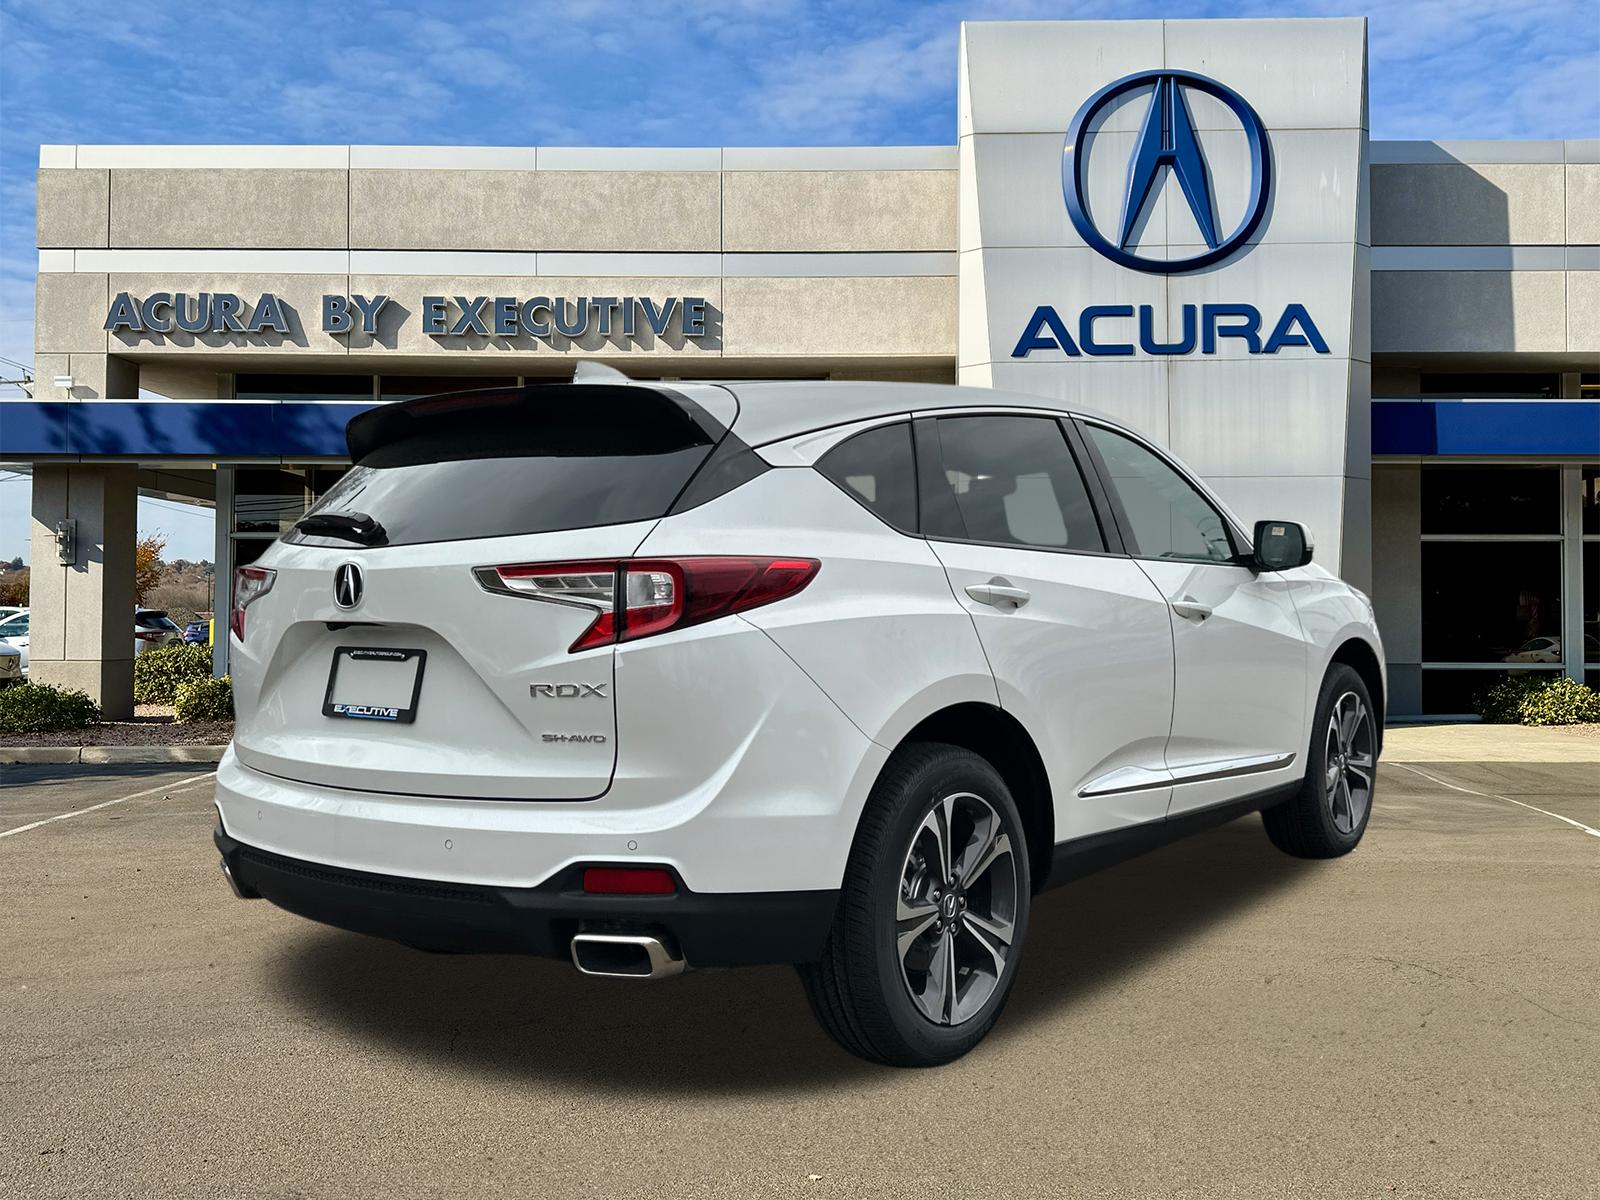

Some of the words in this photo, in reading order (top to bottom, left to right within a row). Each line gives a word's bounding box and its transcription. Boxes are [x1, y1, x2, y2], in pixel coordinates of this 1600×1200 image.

[103, 291, 290, 333] ACURA
[322, 294, 391, 333] BY
[421, 295, 706, 337] EXECUTIVE
[1011, 303, 1331, 357] ACURA
[529, 682, 608, 698] RDX
[333, 704, 399, 717] EXECUTIVE
